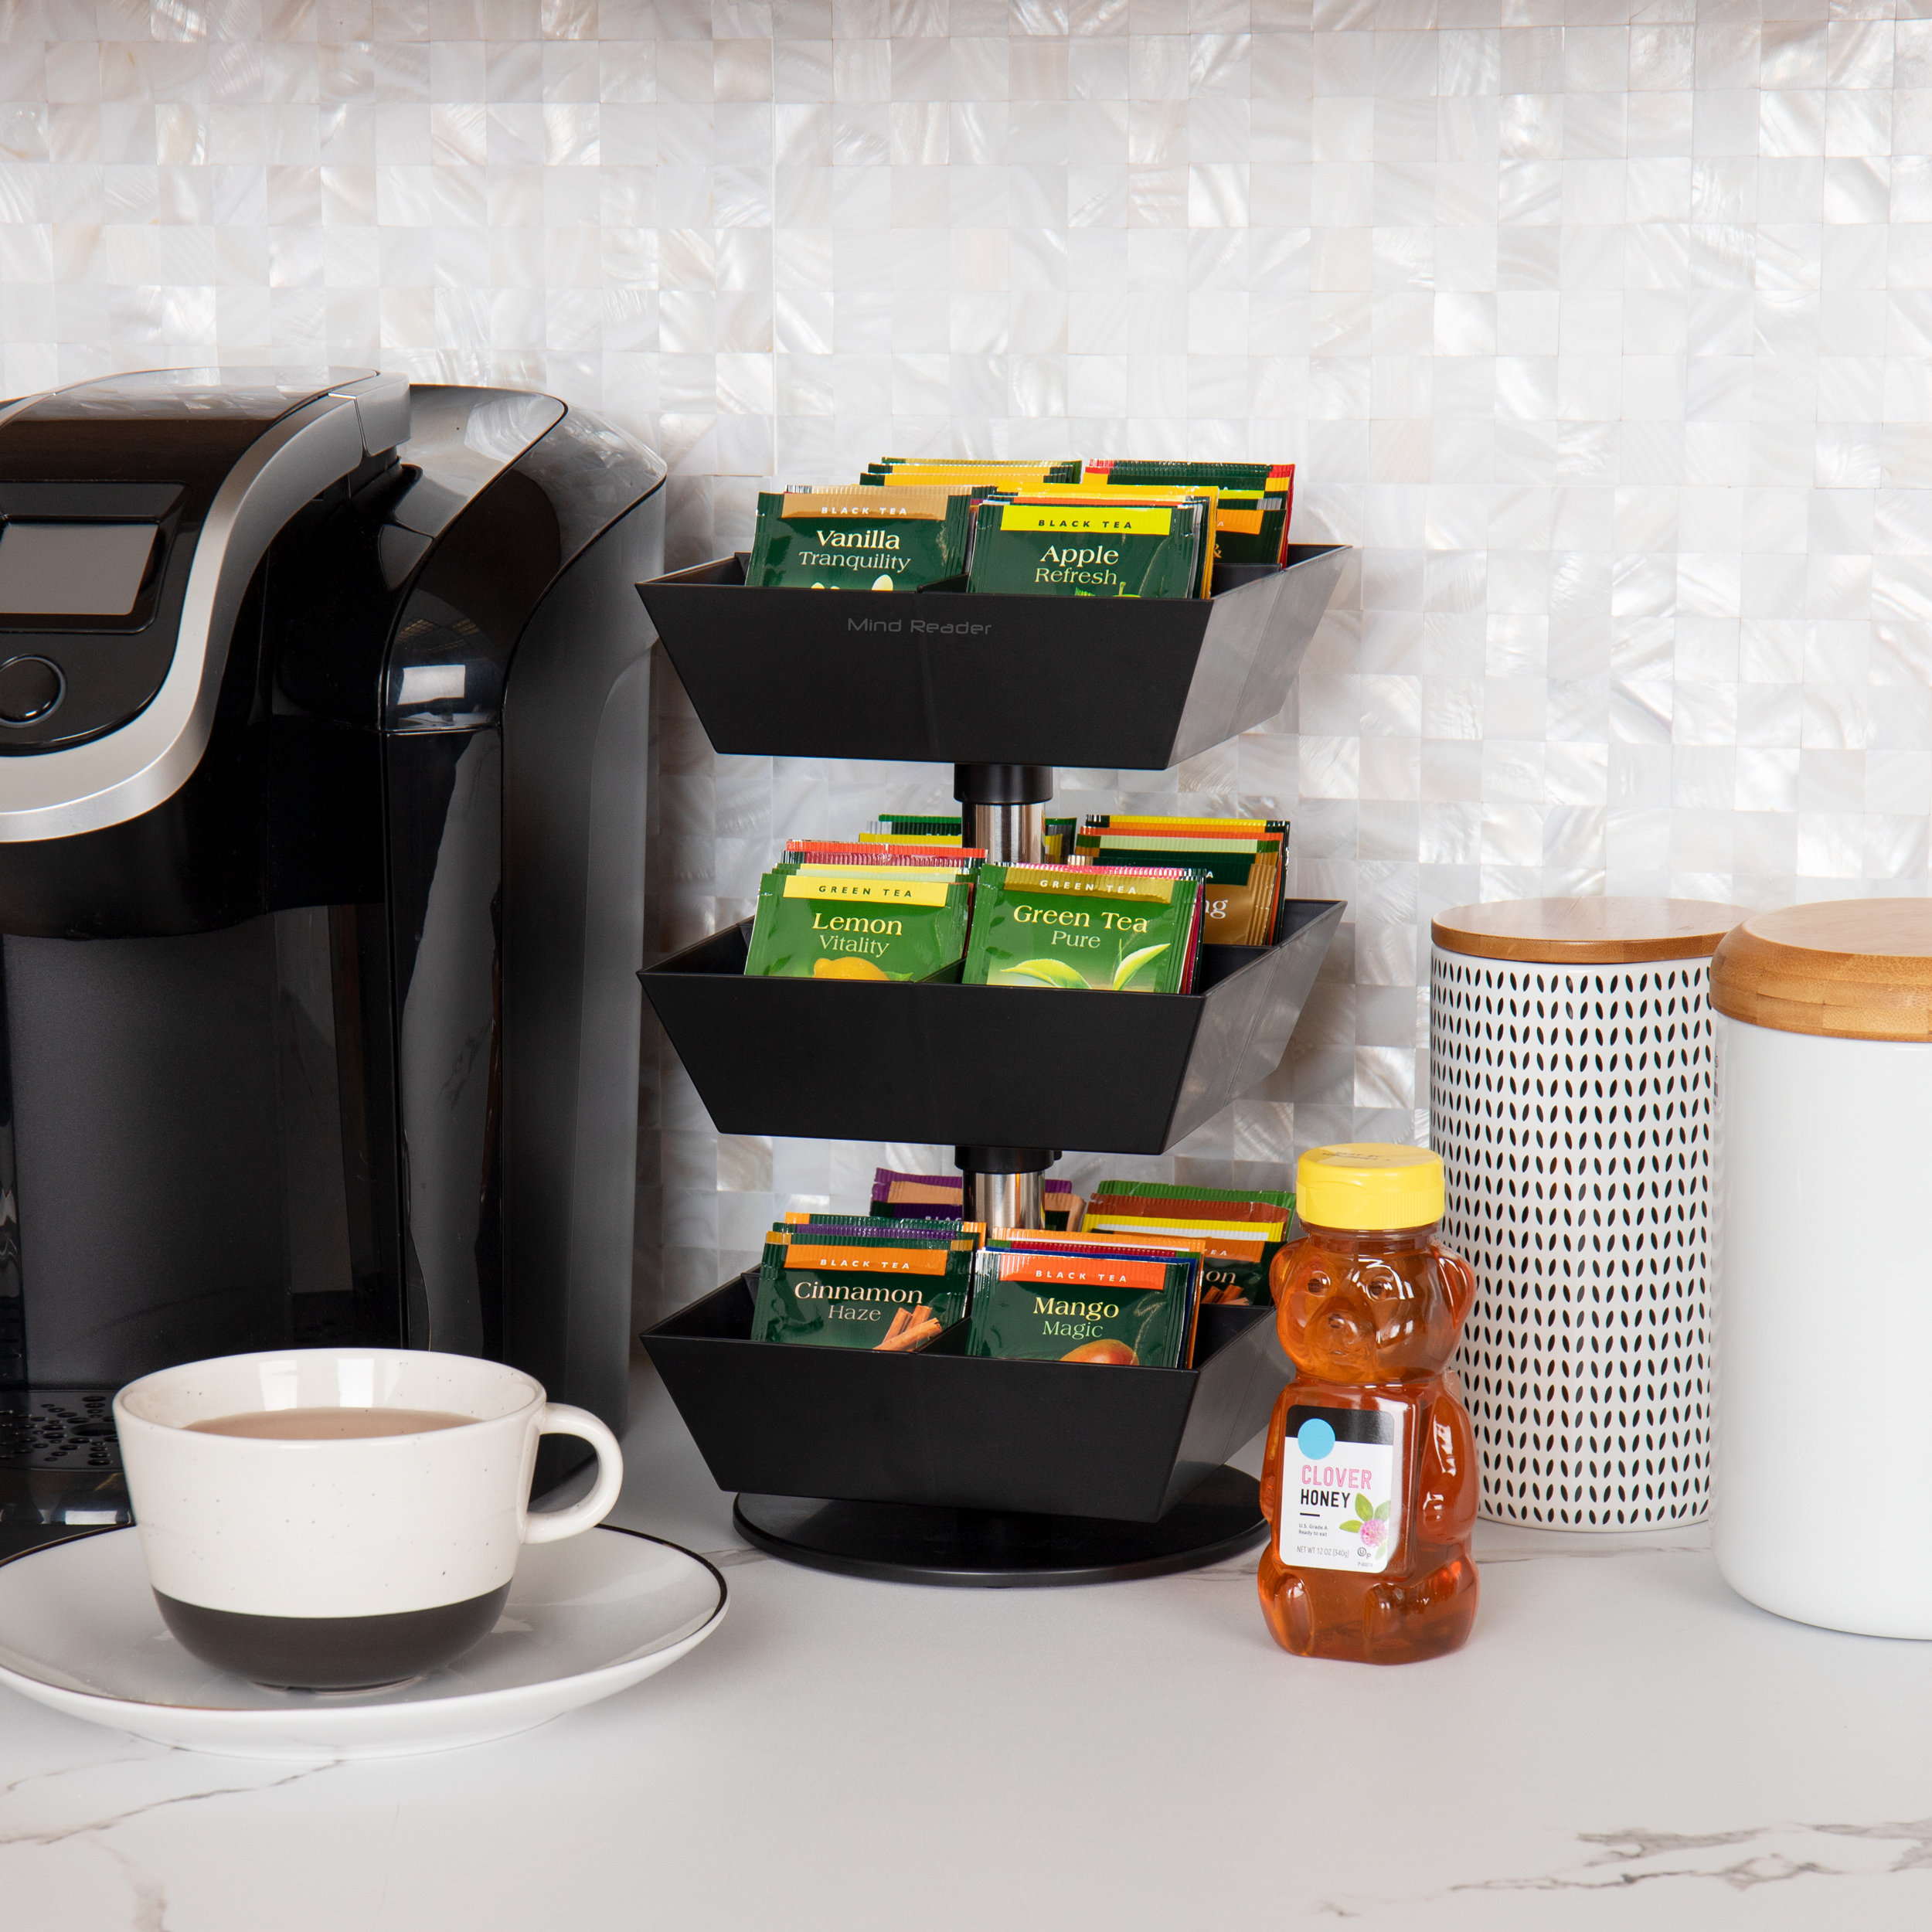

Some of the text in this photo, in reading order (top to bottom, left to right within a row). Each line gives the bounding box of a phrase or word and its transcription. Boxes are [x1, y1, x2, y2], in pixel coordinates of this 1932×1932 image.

[821, 506, 908, 515] BLACK TEA
[1038, 519, 1090, 528] BLACK
[816, 529, 900, 549] Vanilla
[798, 551, 912, 573] Tranquility
[1039, 545, 1119, 567] Apple
[1034, 566, 1117, 585] Refresh
[848, 617, 992, 635] Mind Reader
[818, 886, 912, 897] GREEN TEA
[1039, 879, 1137, 894] GREEN TEA
[812, 913, 903, 936] Lemon
[1013, 904, 1148, 933] Green Tea
[819, 934, 889, 957] Vitality
[1051, 930, 1100, 948] Pure
[820, 1259, 870, 1267] BLACK
[1036, 1270, 1127, 1283] BLACK TEA
[794, 1281, 923, 1304] Cinnamon
[828, 1304, 881, 1321] Haze
[1033, 1297, 1119, 1321] Mango
[1042, 1321, 1104, 1340] Magic
[1301, 1464, 1372, 1490] CLOVER
[1301, 1488, 1351, 1509] HONEY
